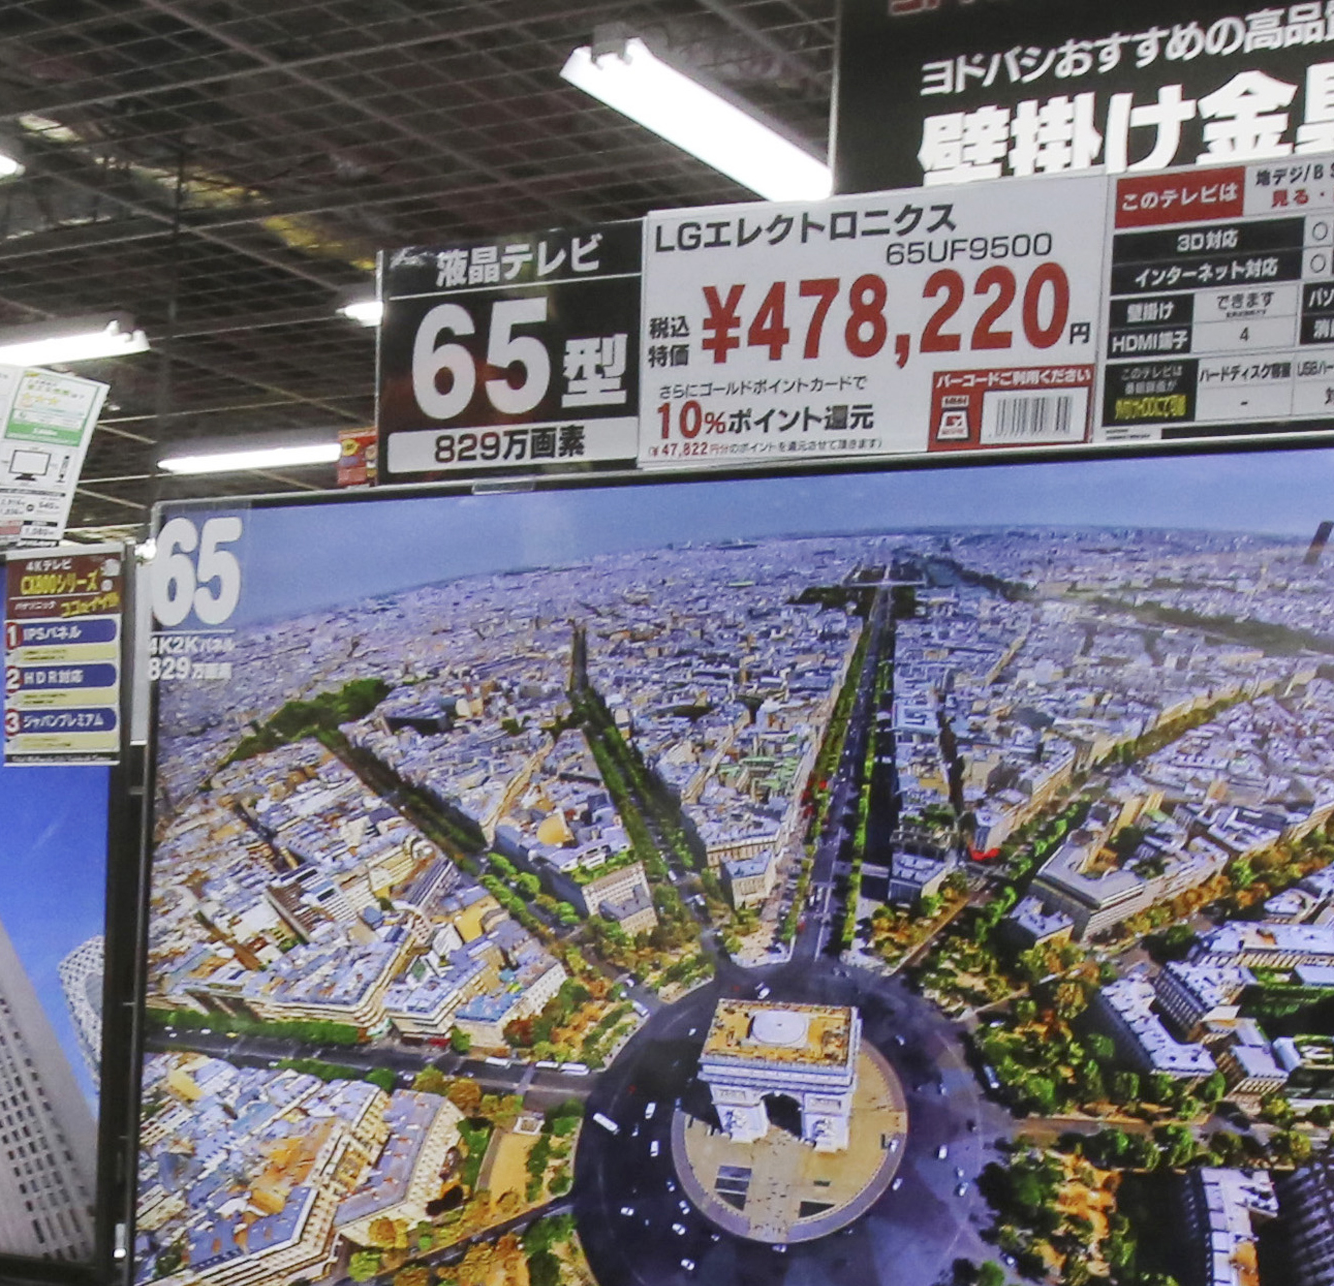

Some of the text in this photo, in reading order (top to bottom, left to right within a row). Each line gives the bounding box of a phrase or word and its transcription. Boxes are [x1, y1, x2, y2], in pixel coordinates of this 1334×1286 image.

[1122, 184, 1238, 212] このテレビは
[655, 203, 957, 252] LGエレクトロニクス
[1177, 229, 1239, 251] 3D対応
[436, 233, 603, 287] 液晶テレビ
[885, 232, 1054, 266] 65UF9500
[1134, 257, 1279, 289] インターネット対応
[649, 316, 690, 340] 税込
[1239, 327, 1250, 342] 4
[434, 425, 585, 463] 829万画素
[150, 517, 243, 626] 65
